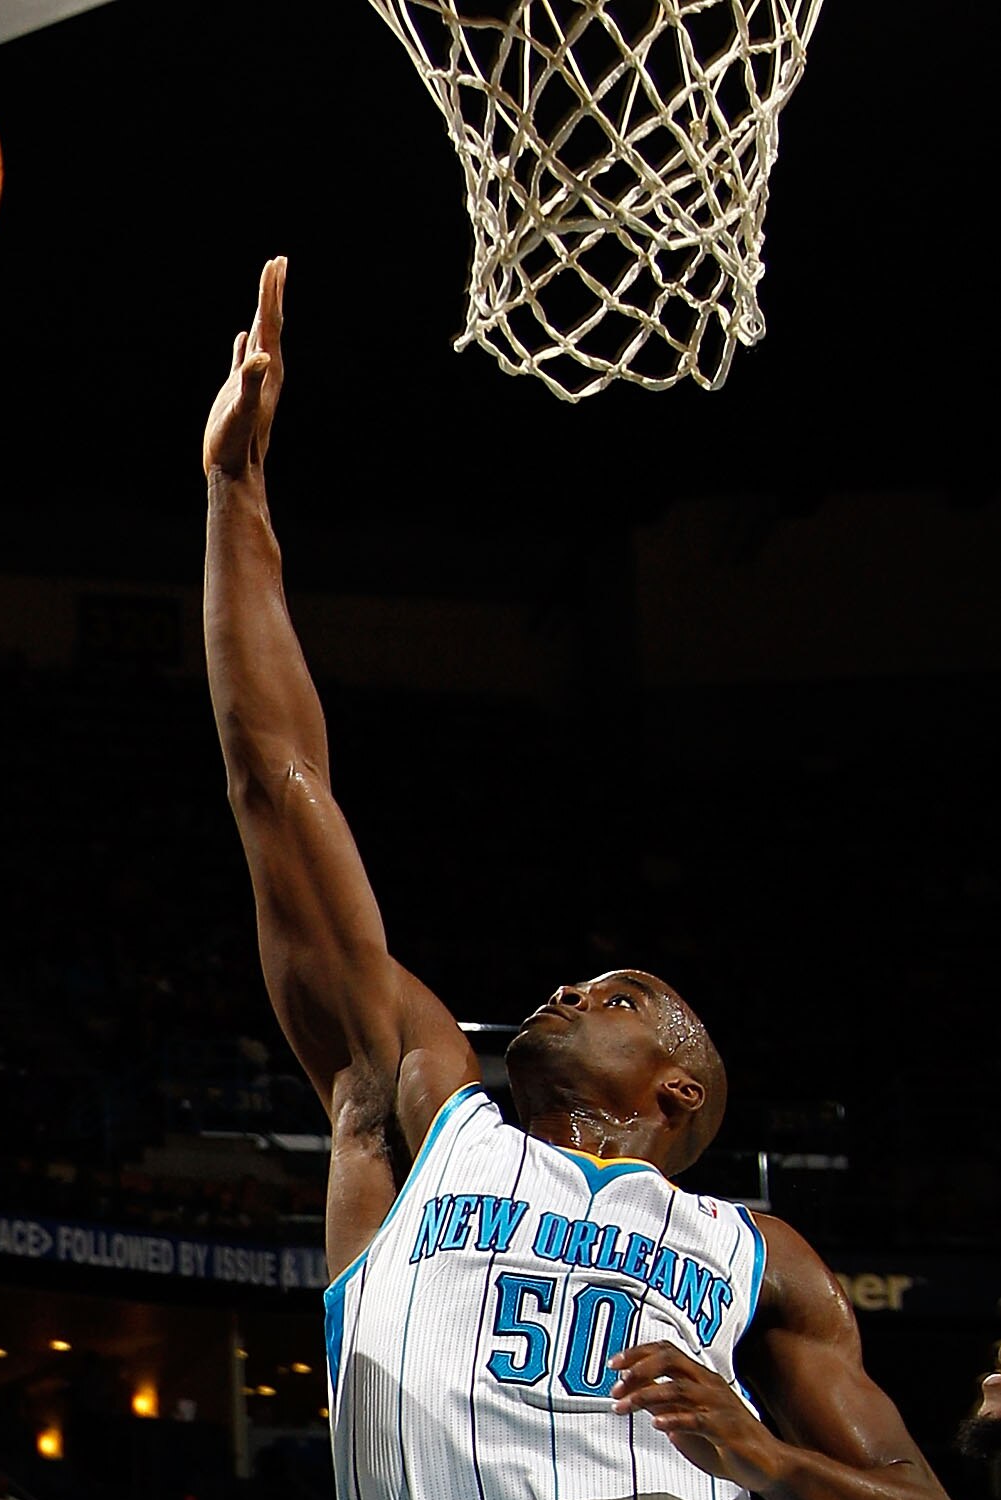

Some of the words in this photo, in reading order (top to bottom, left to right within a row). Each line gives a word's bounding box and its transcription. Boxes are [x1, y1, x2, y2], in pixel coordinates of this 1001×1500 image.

[57, 1225, 175, 1274] FOLLOWED
[178, 1240, 208, 1278] BY
[212, 1243, 276, 1284] ISSUE
[409, 1192, 529, 1265] NEW
[531, 1209, 734, 1348] ORLEANS
[486, 1272, 640, 1399] 50
